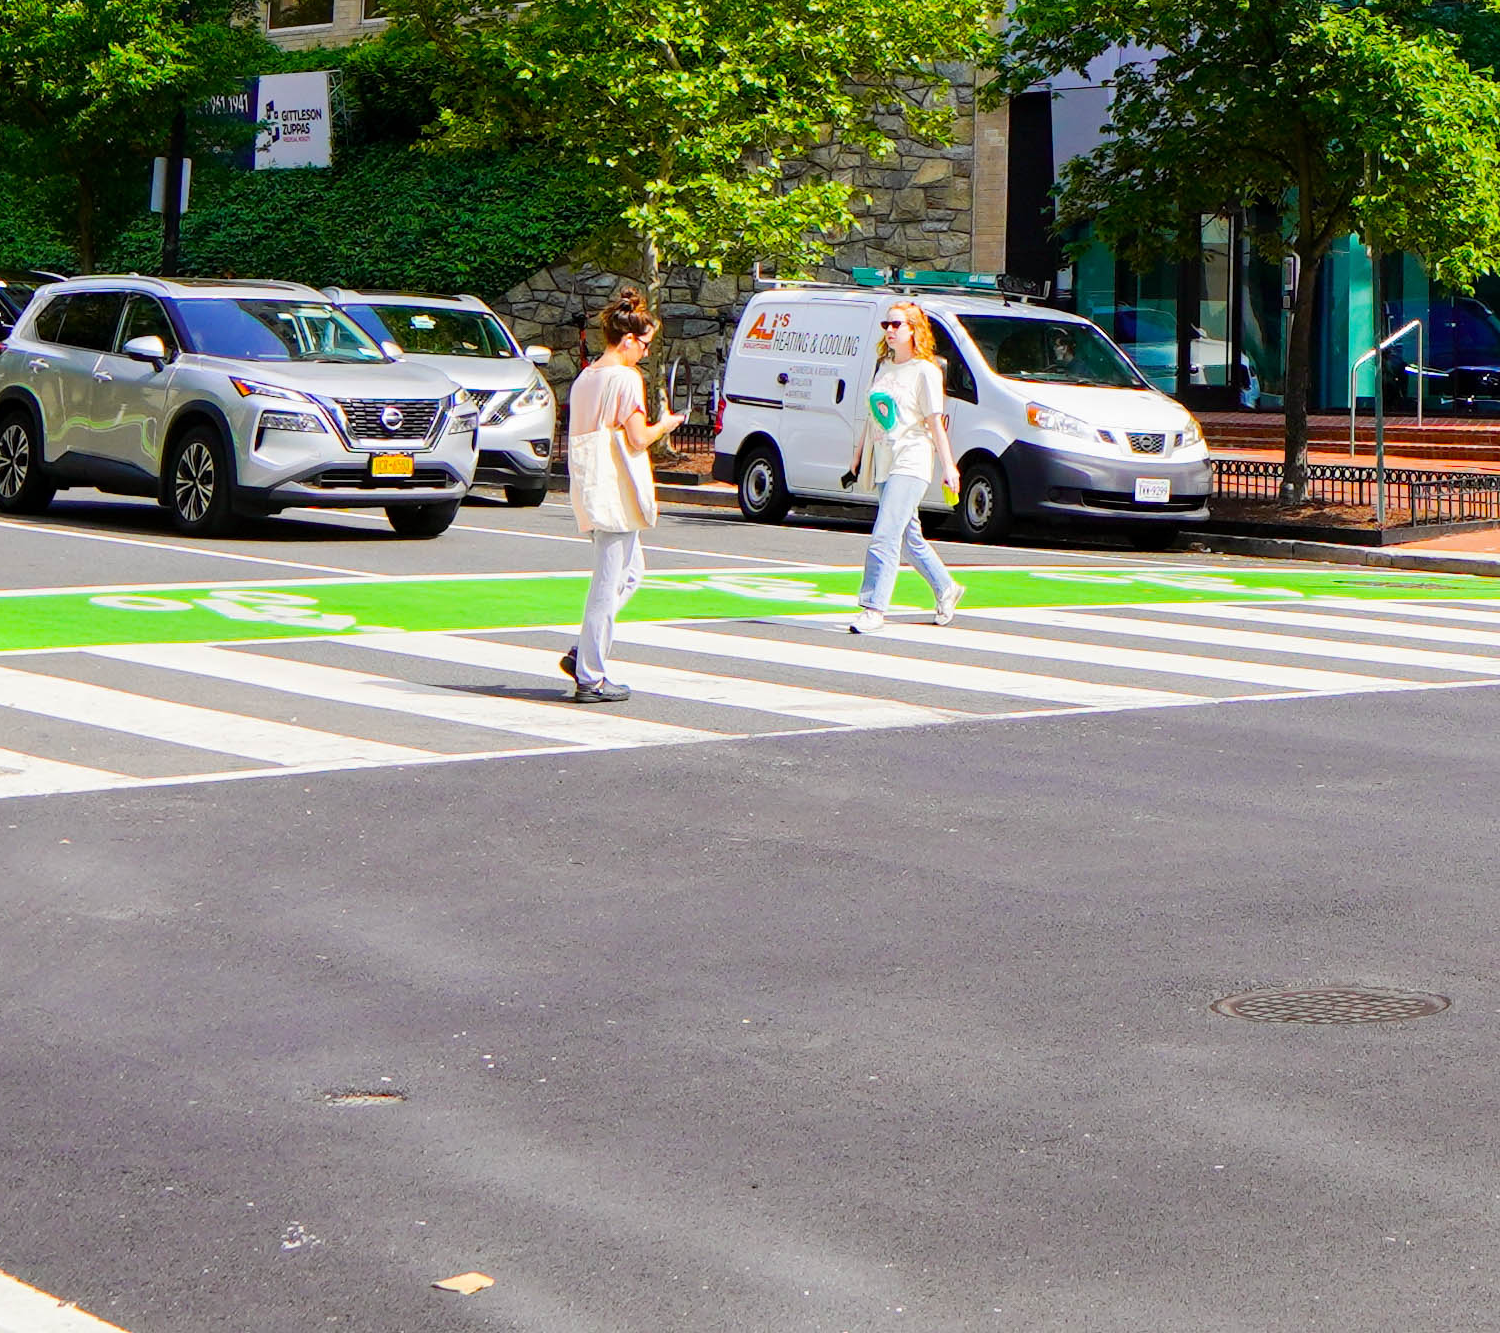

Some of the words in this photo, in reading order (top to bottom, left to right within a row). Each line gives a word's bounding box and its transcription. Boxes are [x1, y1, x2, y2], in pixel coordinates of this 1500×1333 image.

[228, 93, 249, 113] 1941
[282, 109, 322, 121] GITTLESON
[282, 123, 310, 135] ZUPPAS
[773, 331, 810, 353] HEATING
[810, 334, 818, 353] &
[819, 334, 860, 357] COOLING
